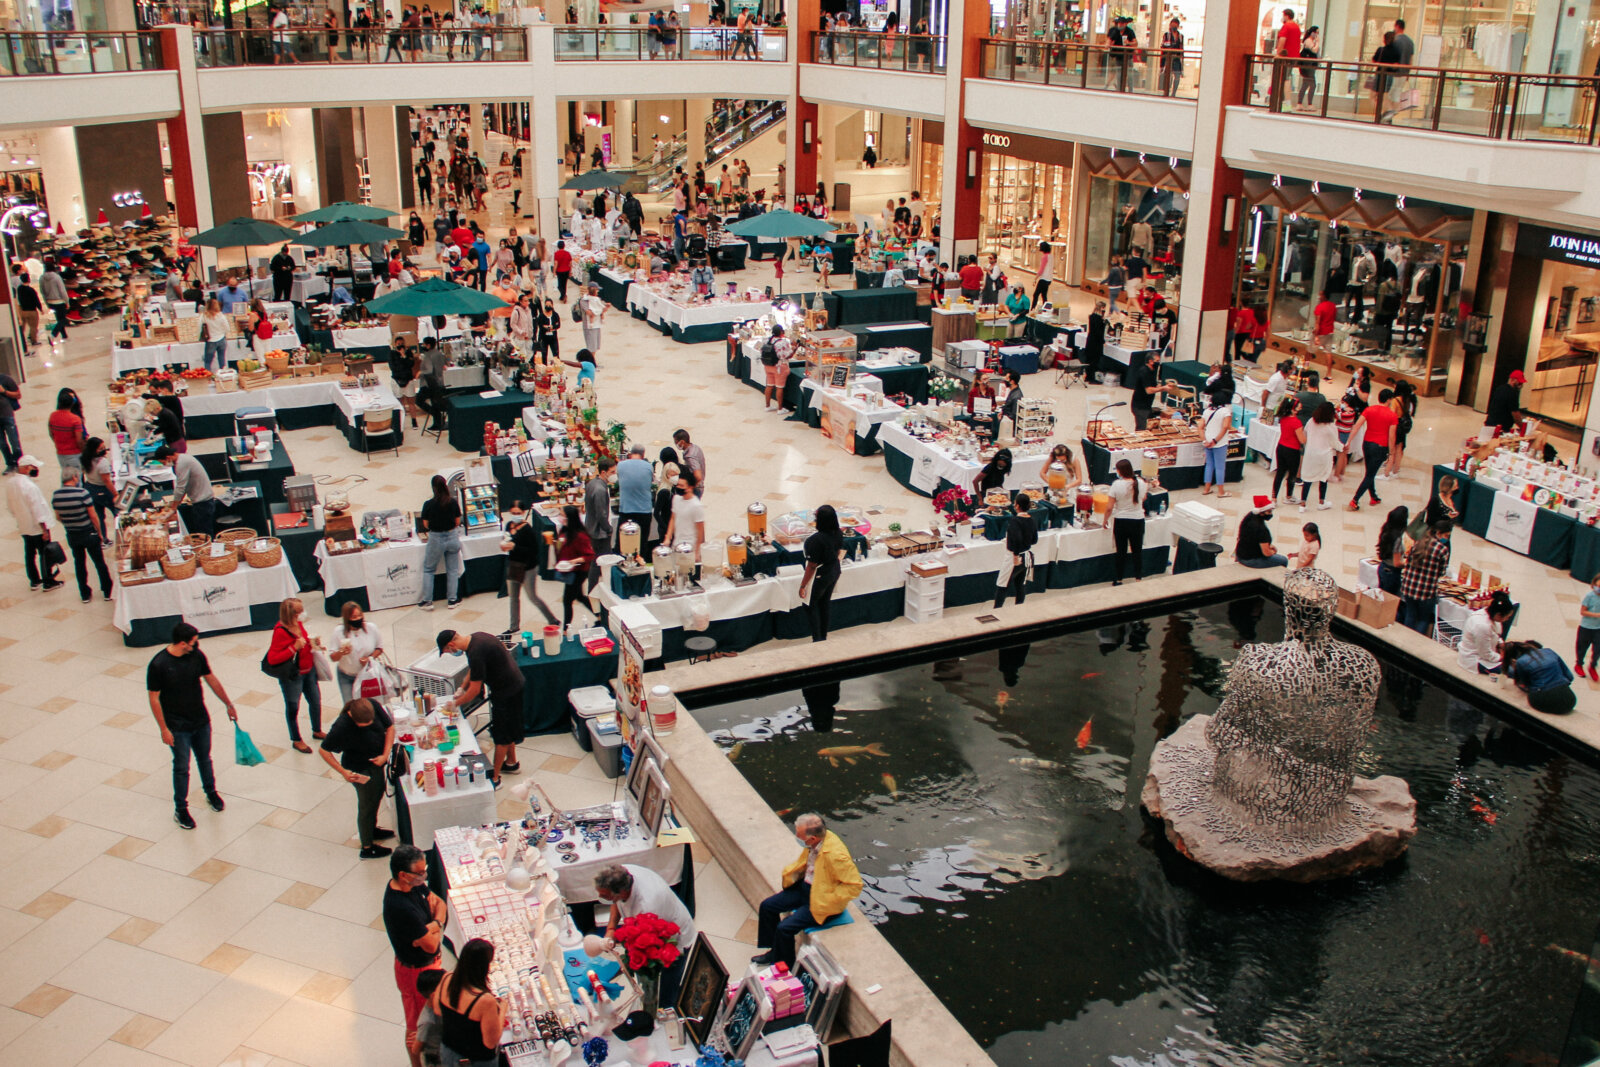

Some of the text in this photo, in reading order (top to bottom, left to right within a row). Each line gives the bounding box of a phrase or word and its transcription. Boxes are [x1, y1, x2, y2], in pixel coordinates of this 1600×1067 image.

[990, 134, 1010, 147] CHOO
[113, 190, 143, 207] COS
[1549, 235, 1600, 255] JOHN HA
